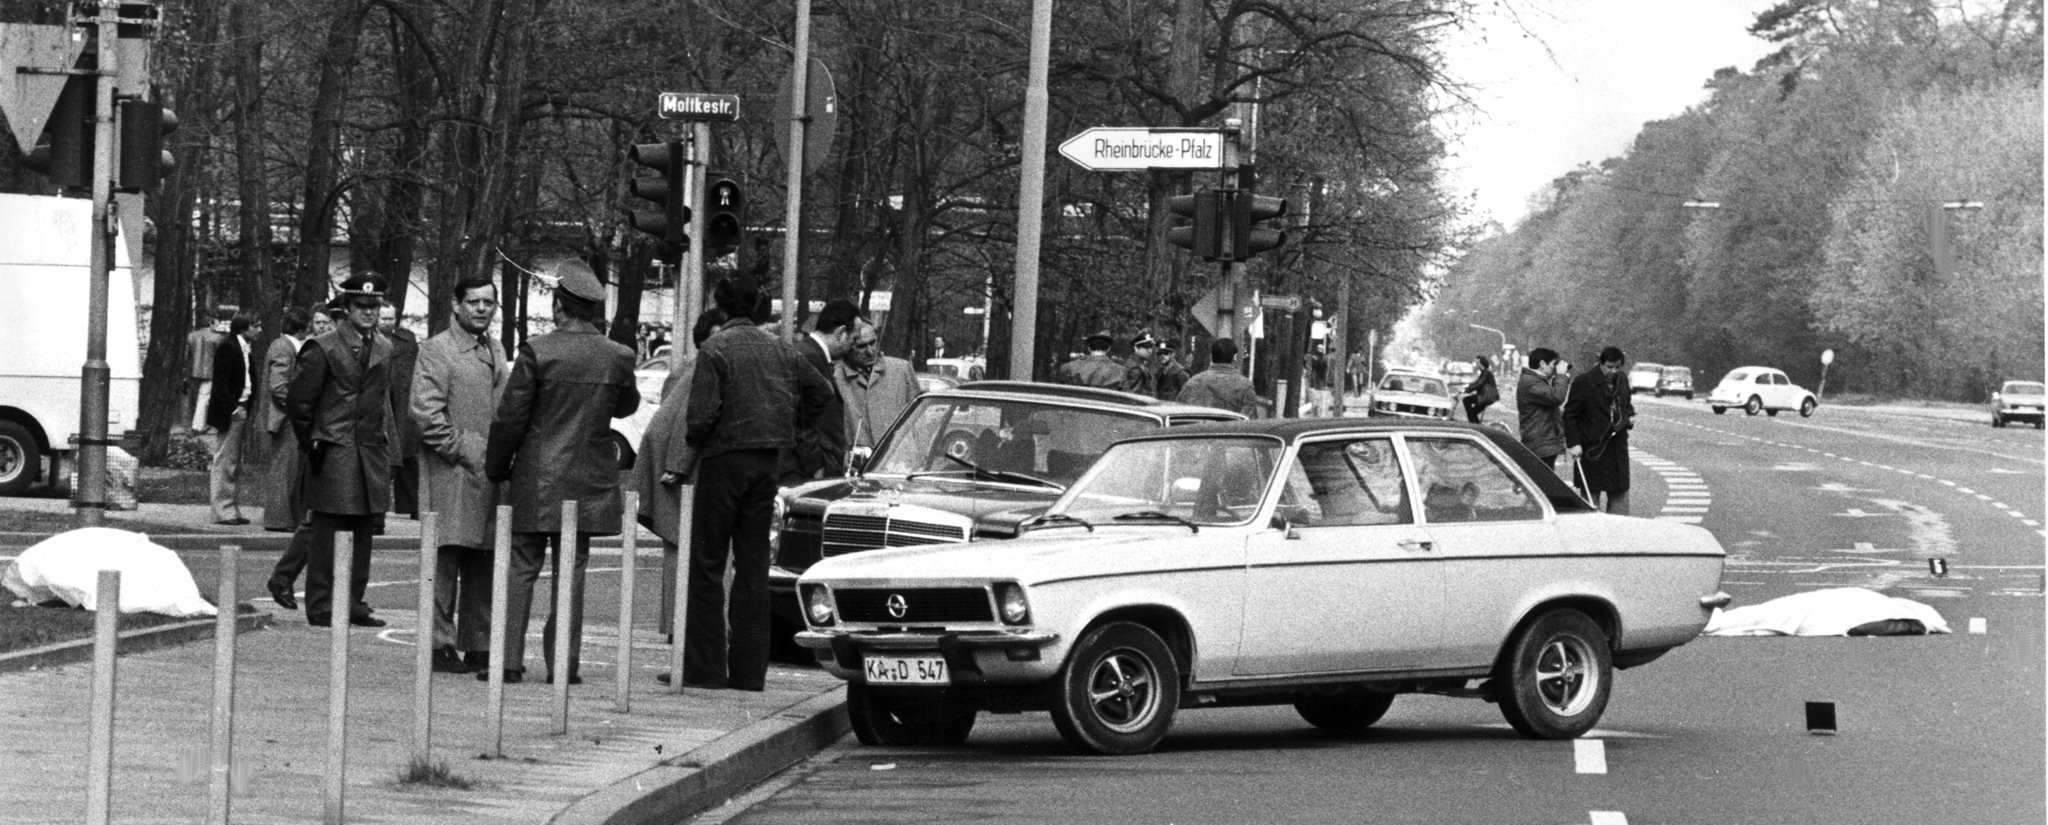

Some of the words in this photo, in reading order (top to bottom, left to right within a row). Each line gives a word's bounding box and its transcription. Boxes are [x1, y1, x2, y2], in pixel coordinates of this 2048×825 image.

[663, 96, 733, 114] Moltkestr.
[1094, 138, 1212, 159] Rheinbrücke-Pfalz
[917, 660, 944, 680] 547
